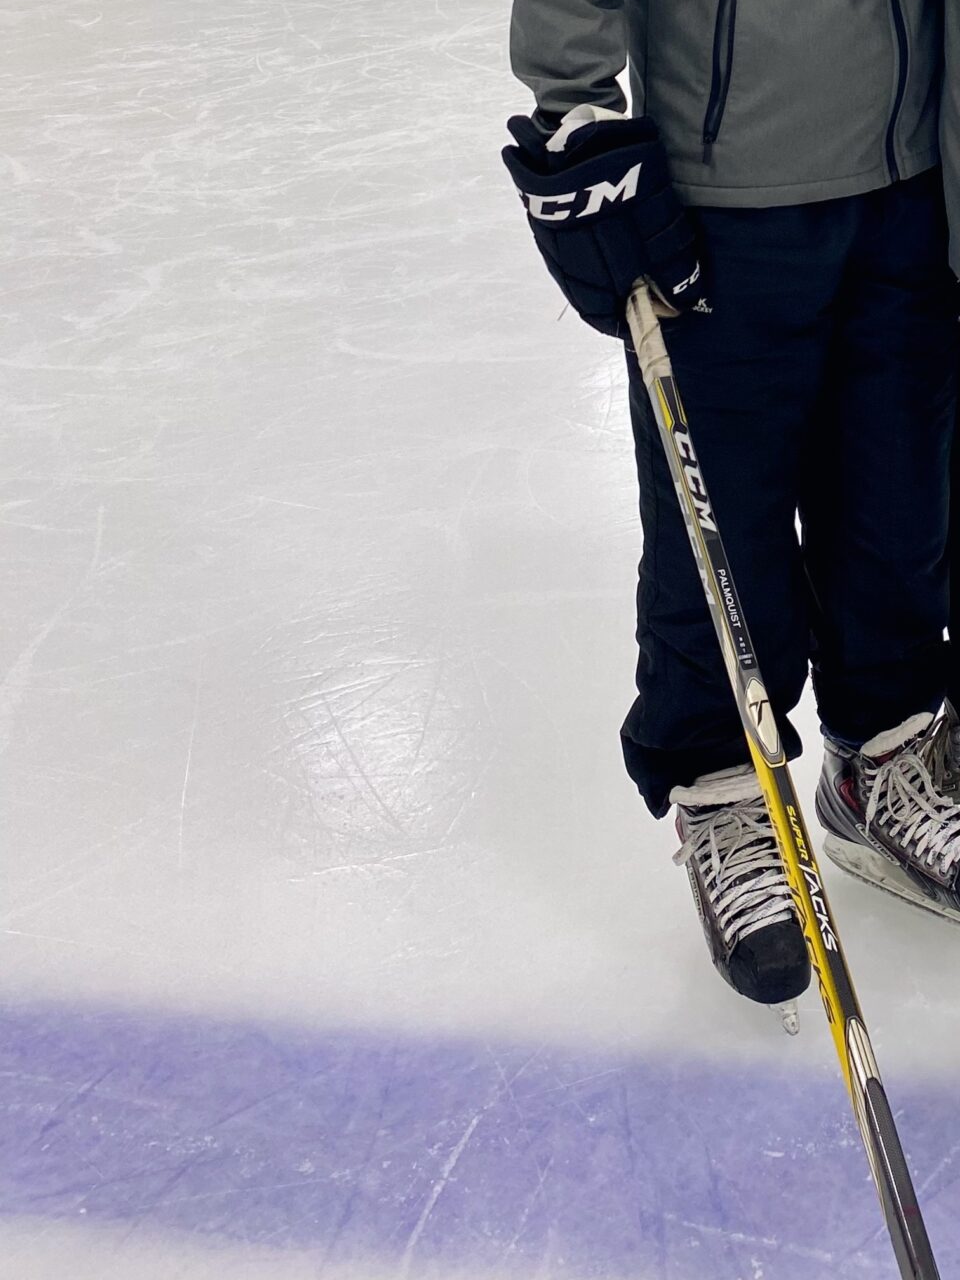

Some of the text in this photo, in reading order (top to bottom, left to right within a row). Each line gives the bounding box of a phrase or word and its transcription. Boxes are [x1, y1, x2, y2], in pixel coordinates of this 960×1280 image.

[518, 162, 642, 220] CM
[673, 430, 718, 532] CCM
[718, 568, 742, 628] PALMQUIST
[787, 805, 838, 953] SUPER TACKS
